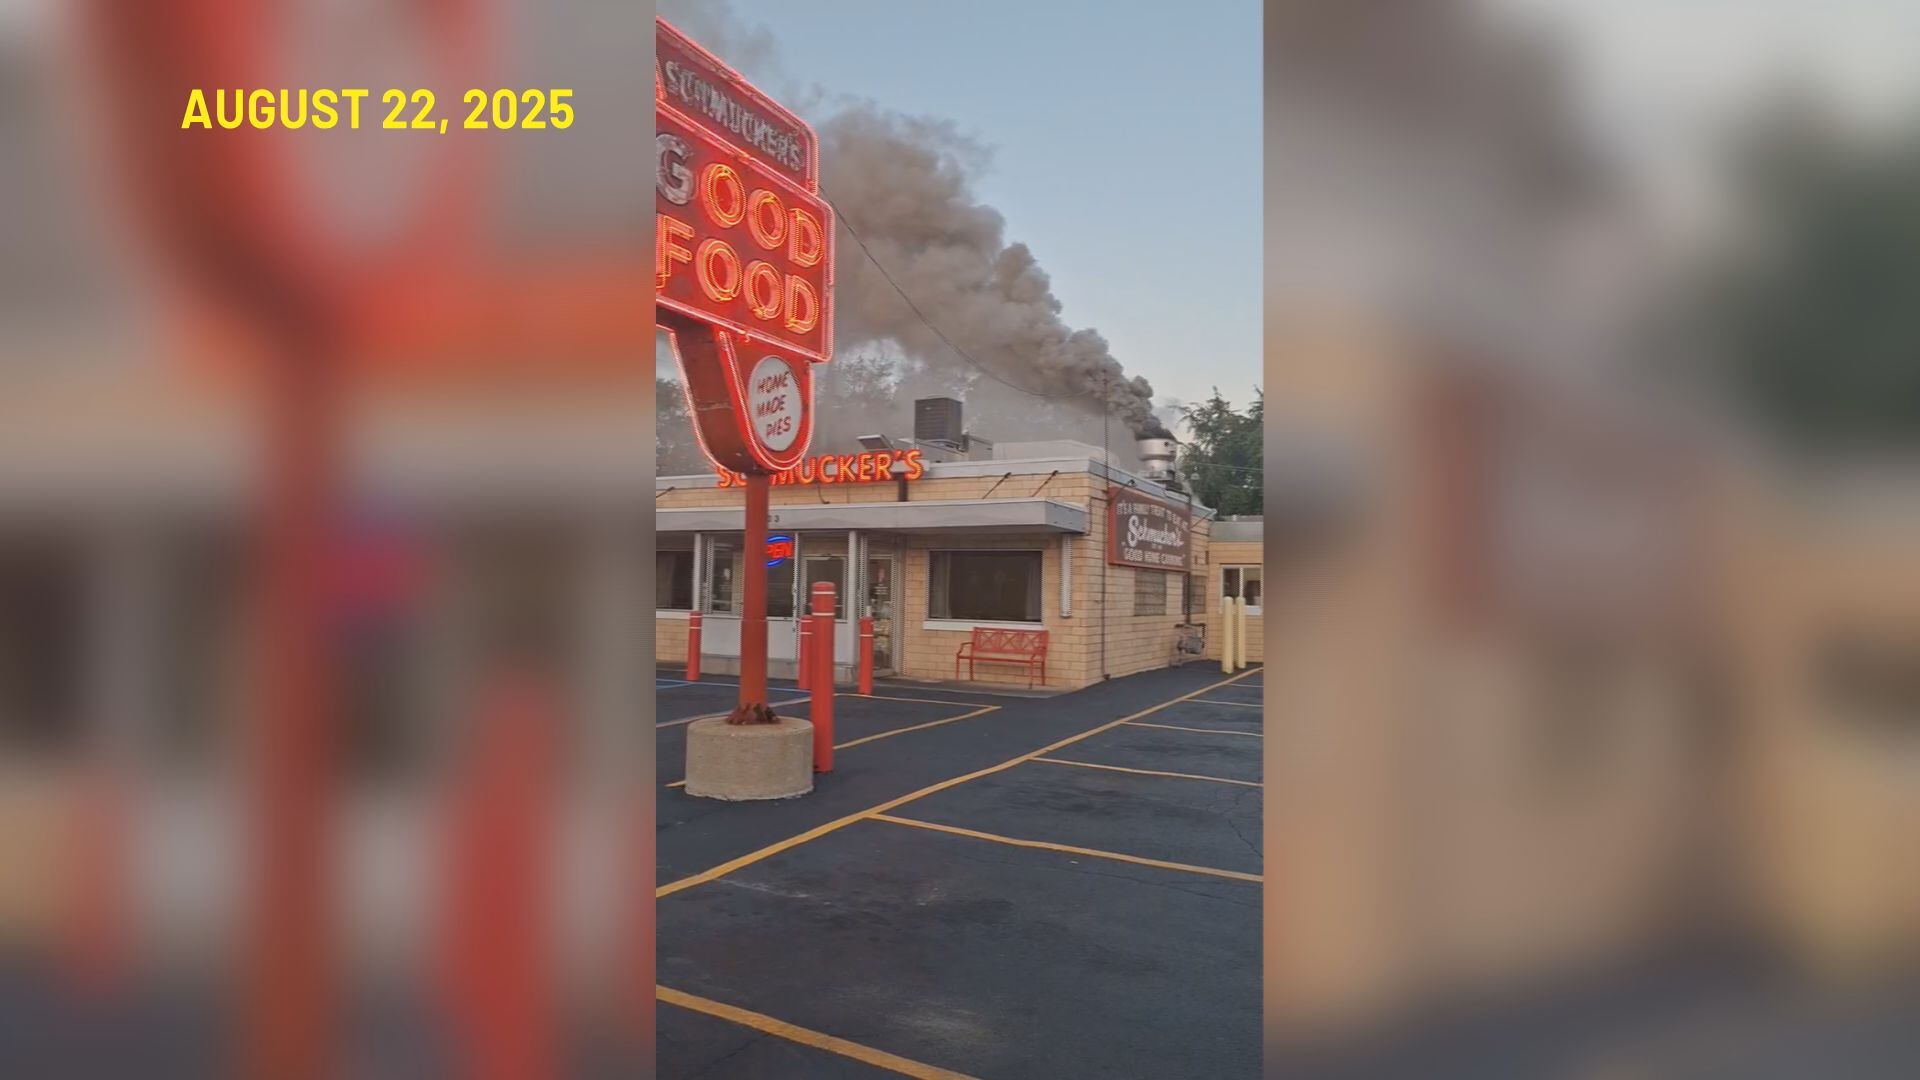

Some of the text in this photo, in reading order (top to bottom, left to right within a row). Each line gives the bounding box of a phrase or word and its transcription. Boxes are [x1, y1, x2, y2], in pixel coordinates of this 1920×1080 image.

[656, 133, 825, 268] GOOD
[656, 213, 819, 334] FOOD
[758, 372, 790, 393] HOME
[757, 395, 786, 416] MADE
[767, 416, 791, 437] PIES
[717, 449, 924, 487] SCMUCKER'S
[766, 541, 793, 559] PEN
